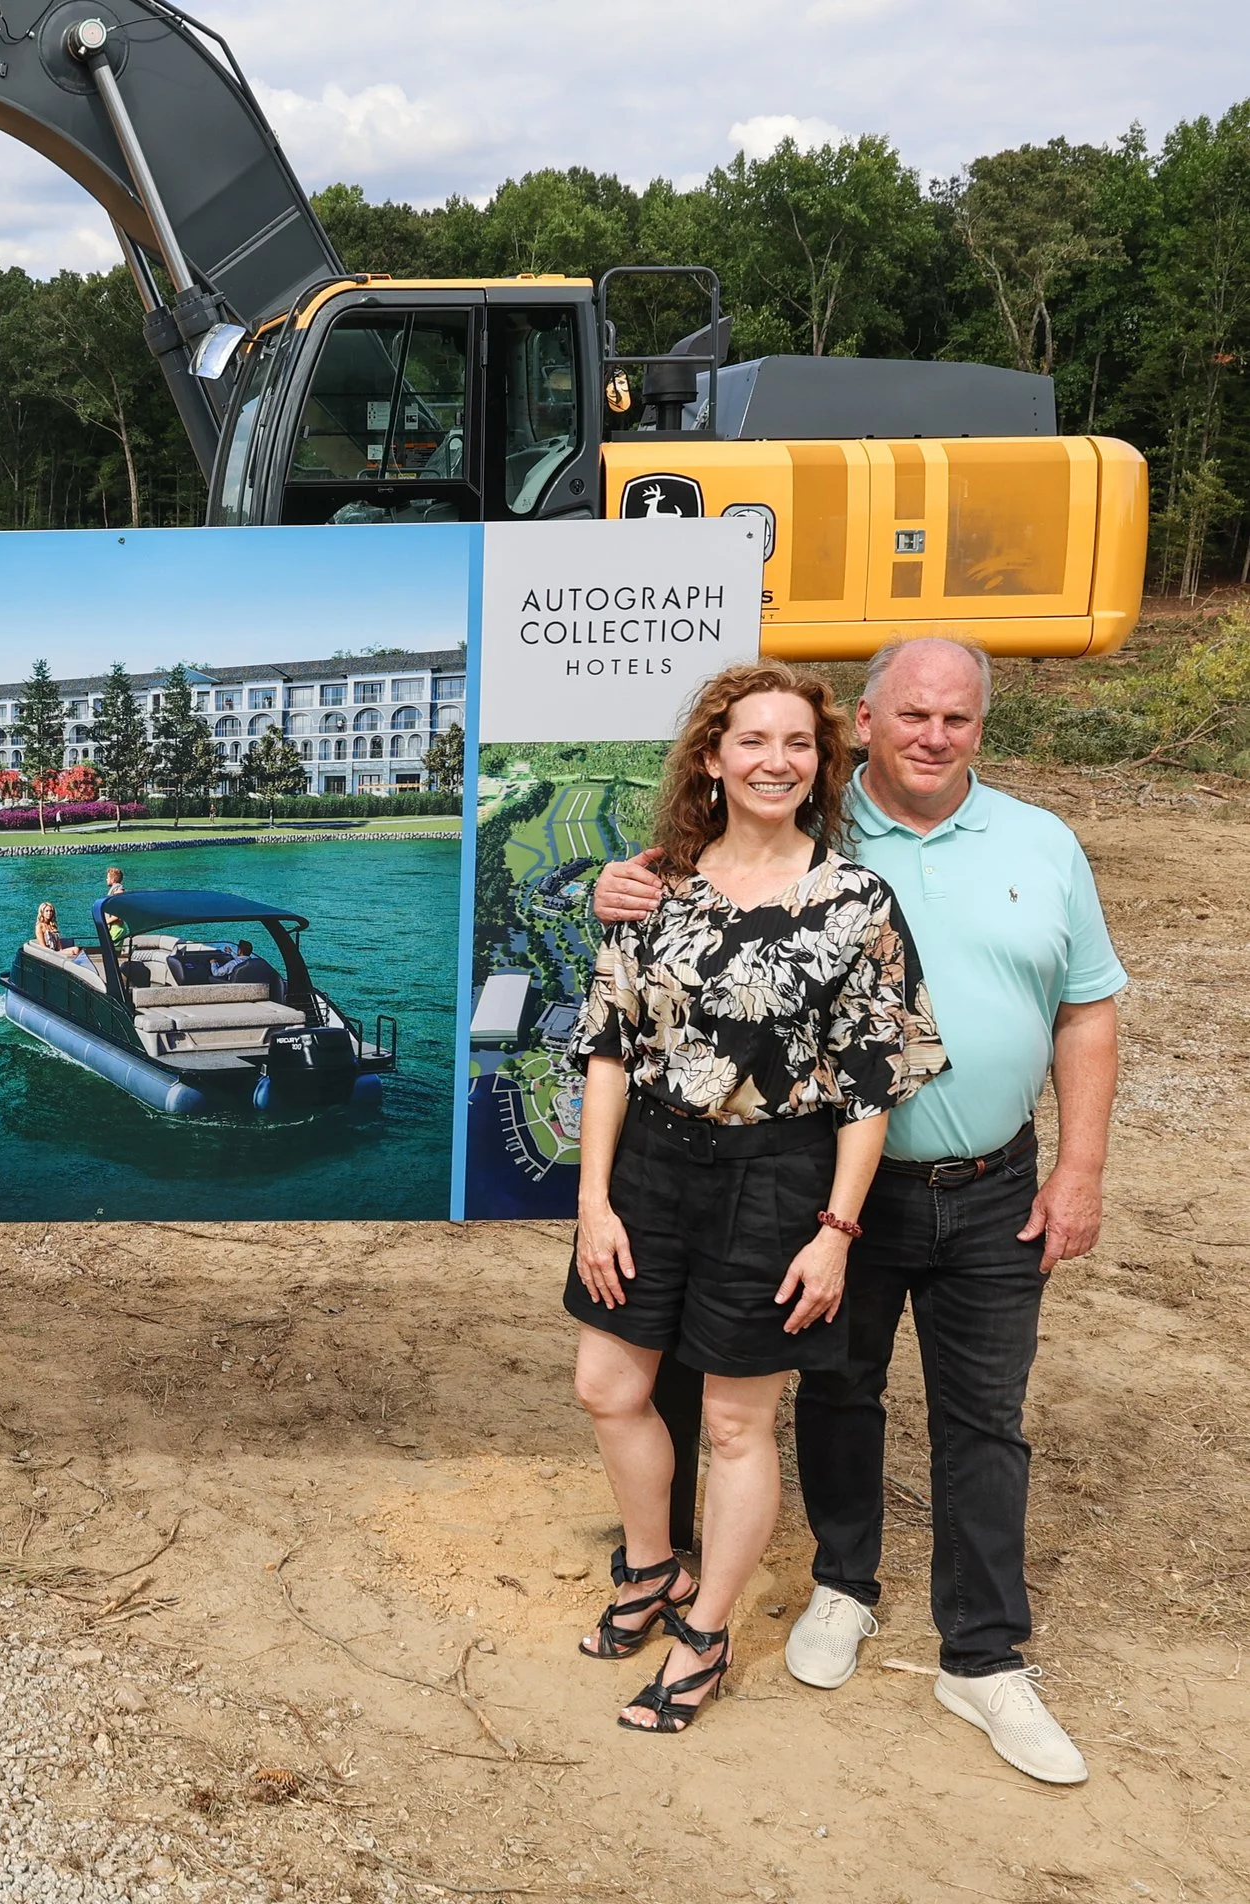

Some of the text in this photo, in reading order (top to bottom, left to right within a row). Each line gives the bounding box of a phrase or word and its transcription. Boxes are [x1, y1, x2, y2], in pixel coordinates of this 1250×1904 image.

[521, 585, 724, 612] AUTOGRAPH
[520, 618, 721, 645] COLLECTION
[566, 658, 672, 676] HOTELS
